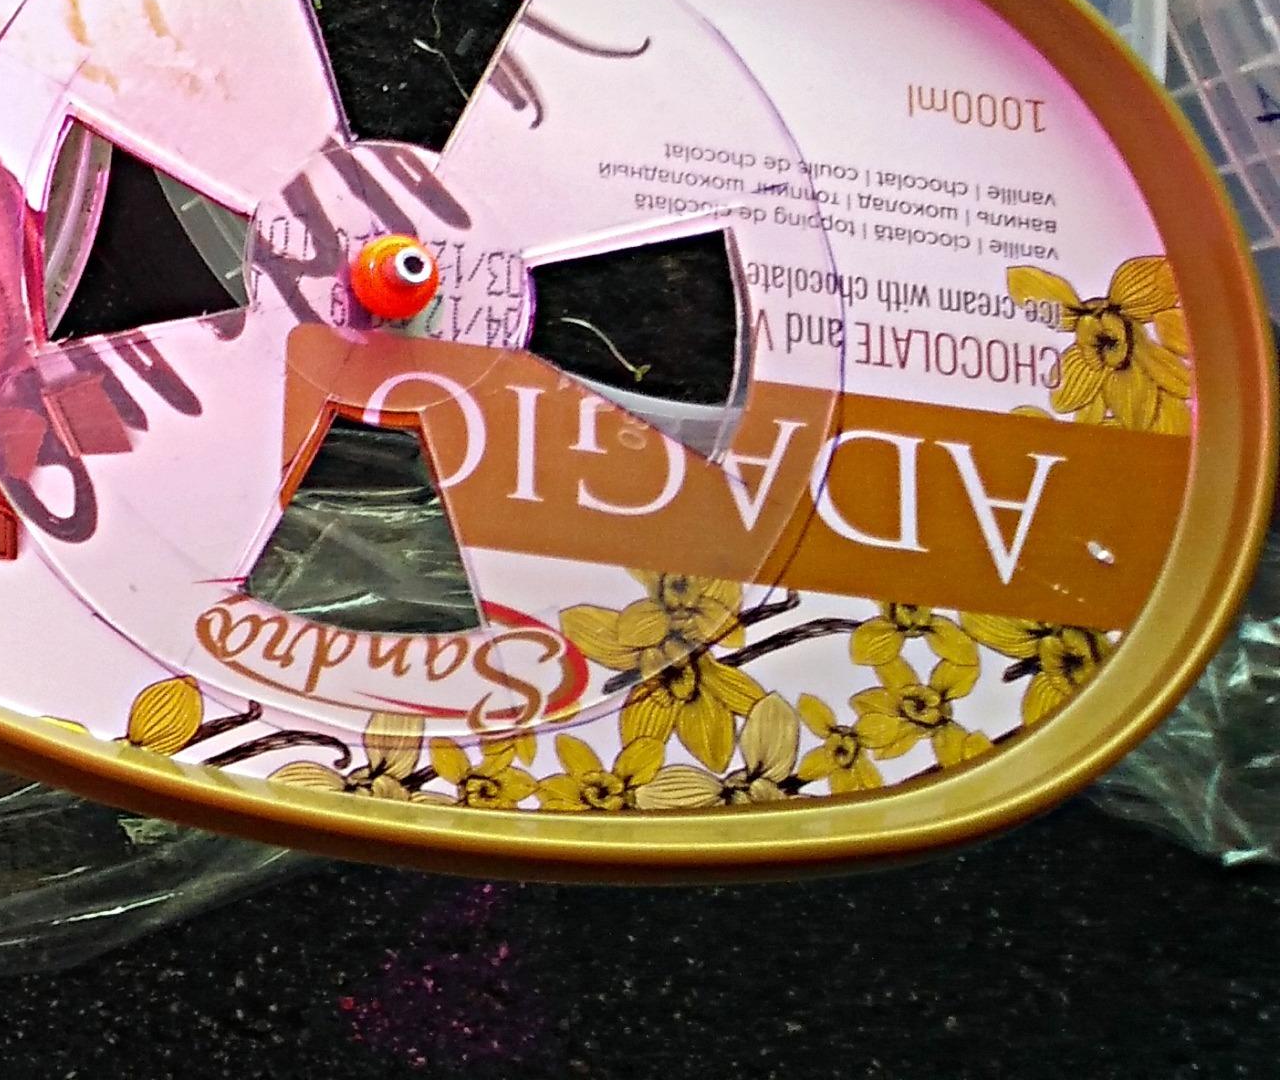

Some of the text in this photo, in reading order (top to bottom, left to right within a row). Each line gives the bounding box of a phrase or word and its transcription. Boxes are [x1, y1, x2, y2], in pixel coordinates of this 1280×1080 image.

[907, 84, 1047, 135] 1000ml
[663, 143, 756, 172] chocolat
[763, 155, 791, 175] de
[598, 161, 745, 194] шоколадный
[876, 171, 968, 200] chocolat
[857, 193, 958, 223] шоколад
[987, 184, 1056, 209] vanille
[737, 206, 767, 226] de
[773, 207, 855, 238] topping
[977, 210, 1057, 235] ваниль
[746, 262, 868, 303] chocolate
[876, 277, 930, 315] with
[938, 286, 1016, 324] cream
[785, 311, 843, 354] and
[854, 321, 1062, 390] CHOCOLATE
[366, 372, 1065, 584] ADAGIO
[196, 606, 562, 734] Sandra
